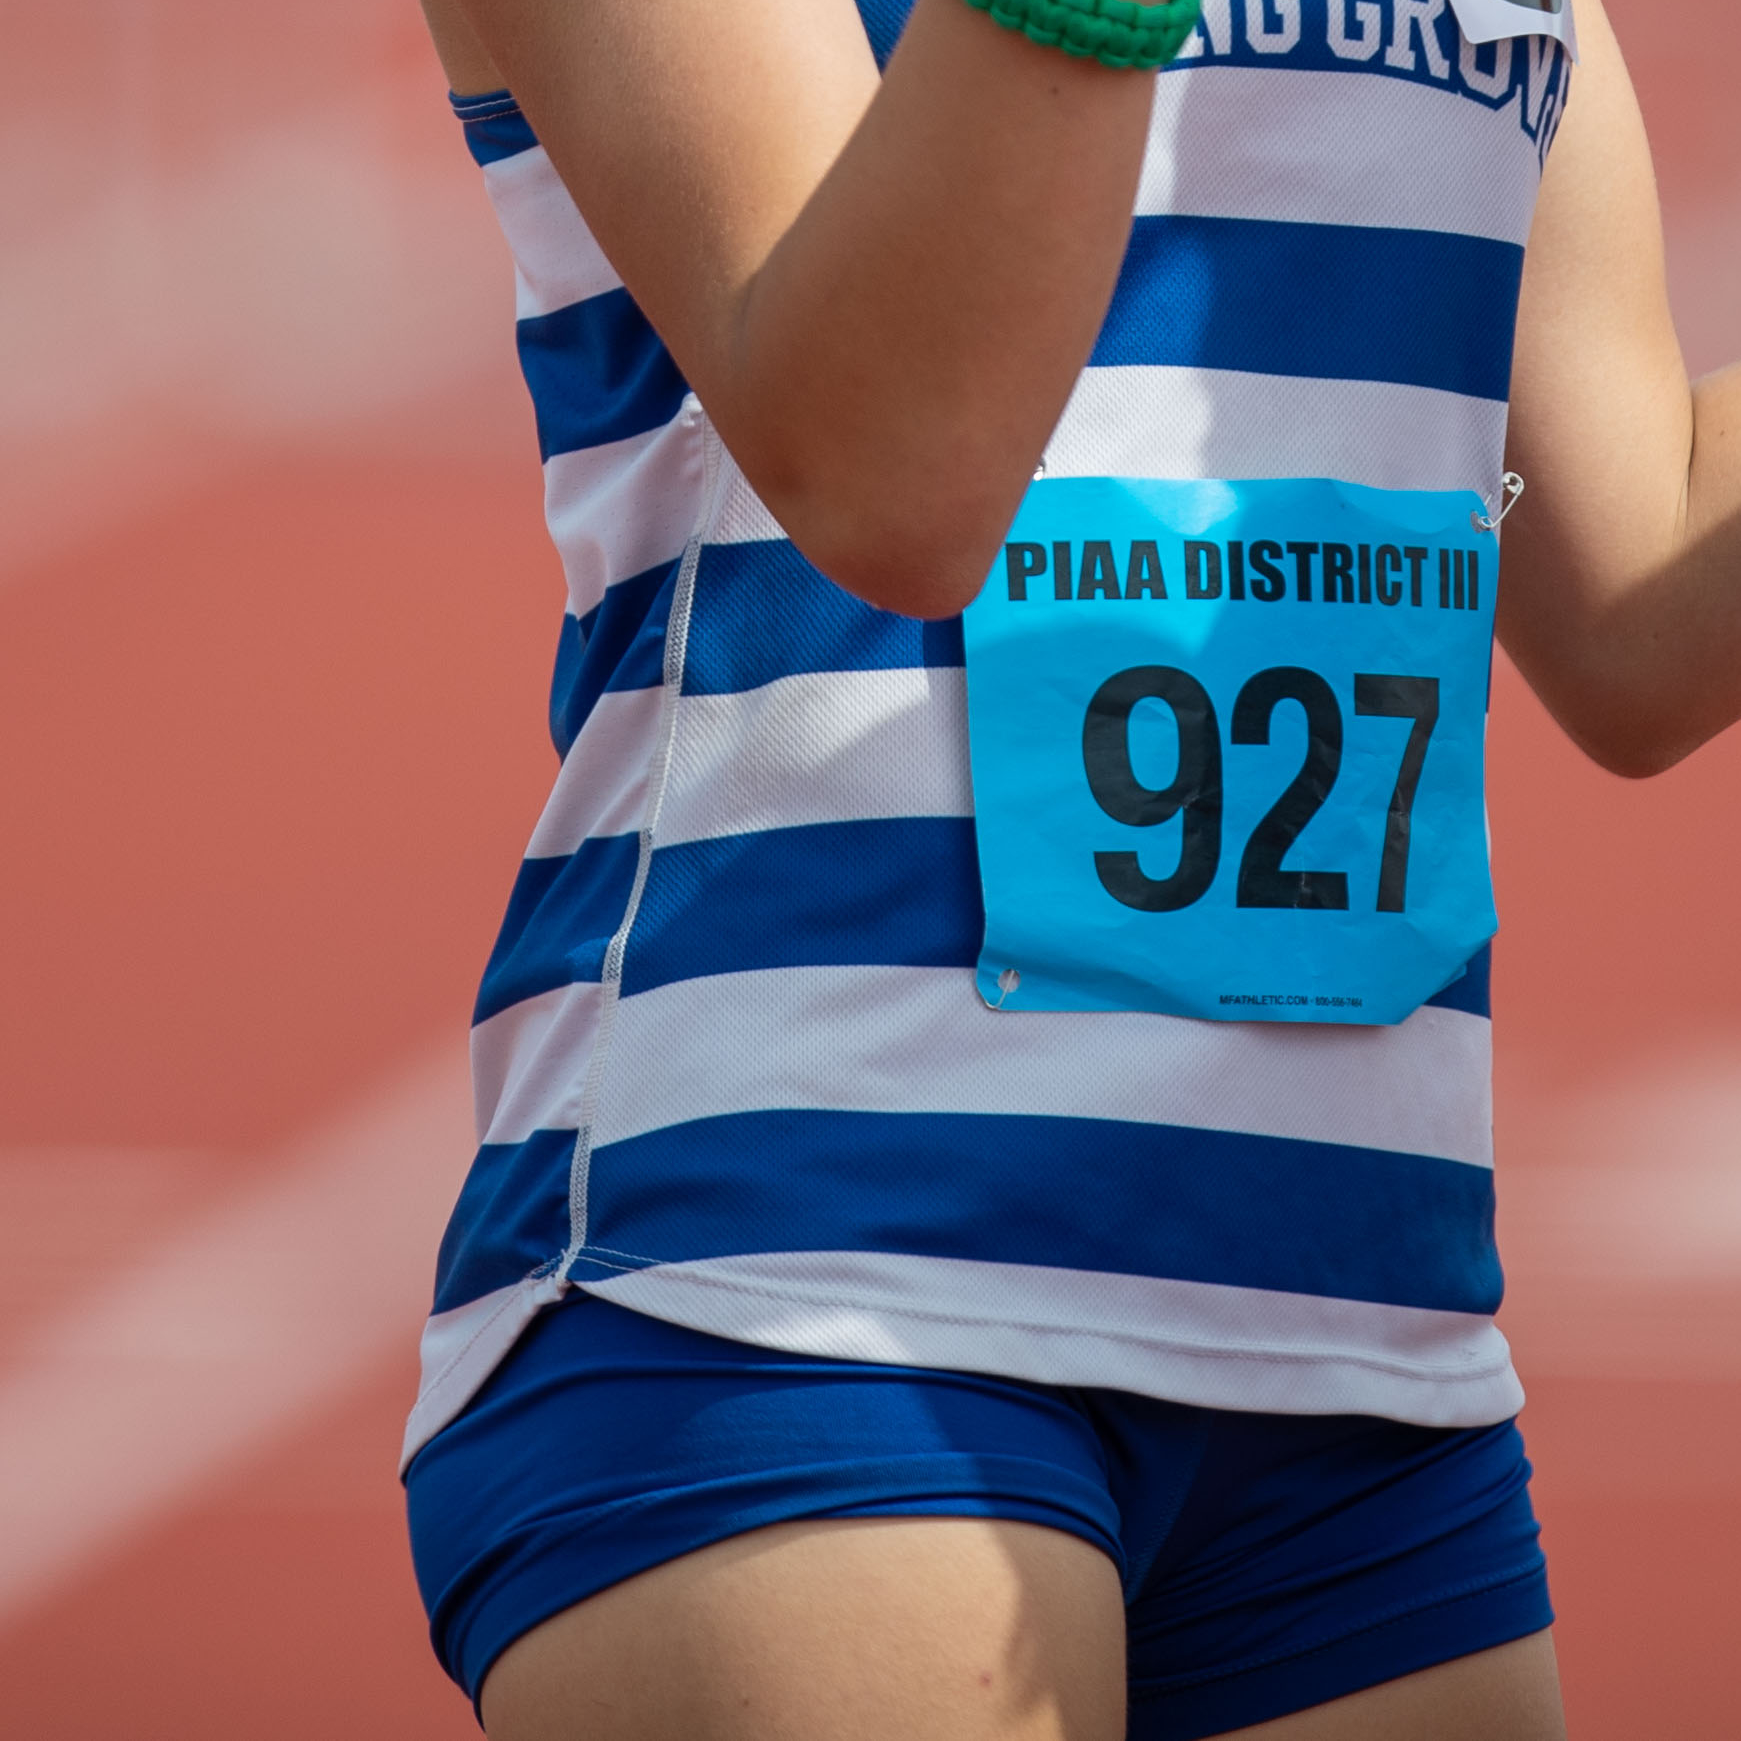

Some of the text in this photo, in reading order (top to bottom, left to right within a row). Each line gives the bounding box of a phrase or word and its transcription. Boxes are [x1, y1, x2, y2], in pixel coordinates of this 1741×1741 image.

[1004, 539, 1480, 611] PIAA DISTRICT III
[1081, 664, 1440, 914] 927
[1219, 994, 1308, 1006] MFATHLETIC.COM
